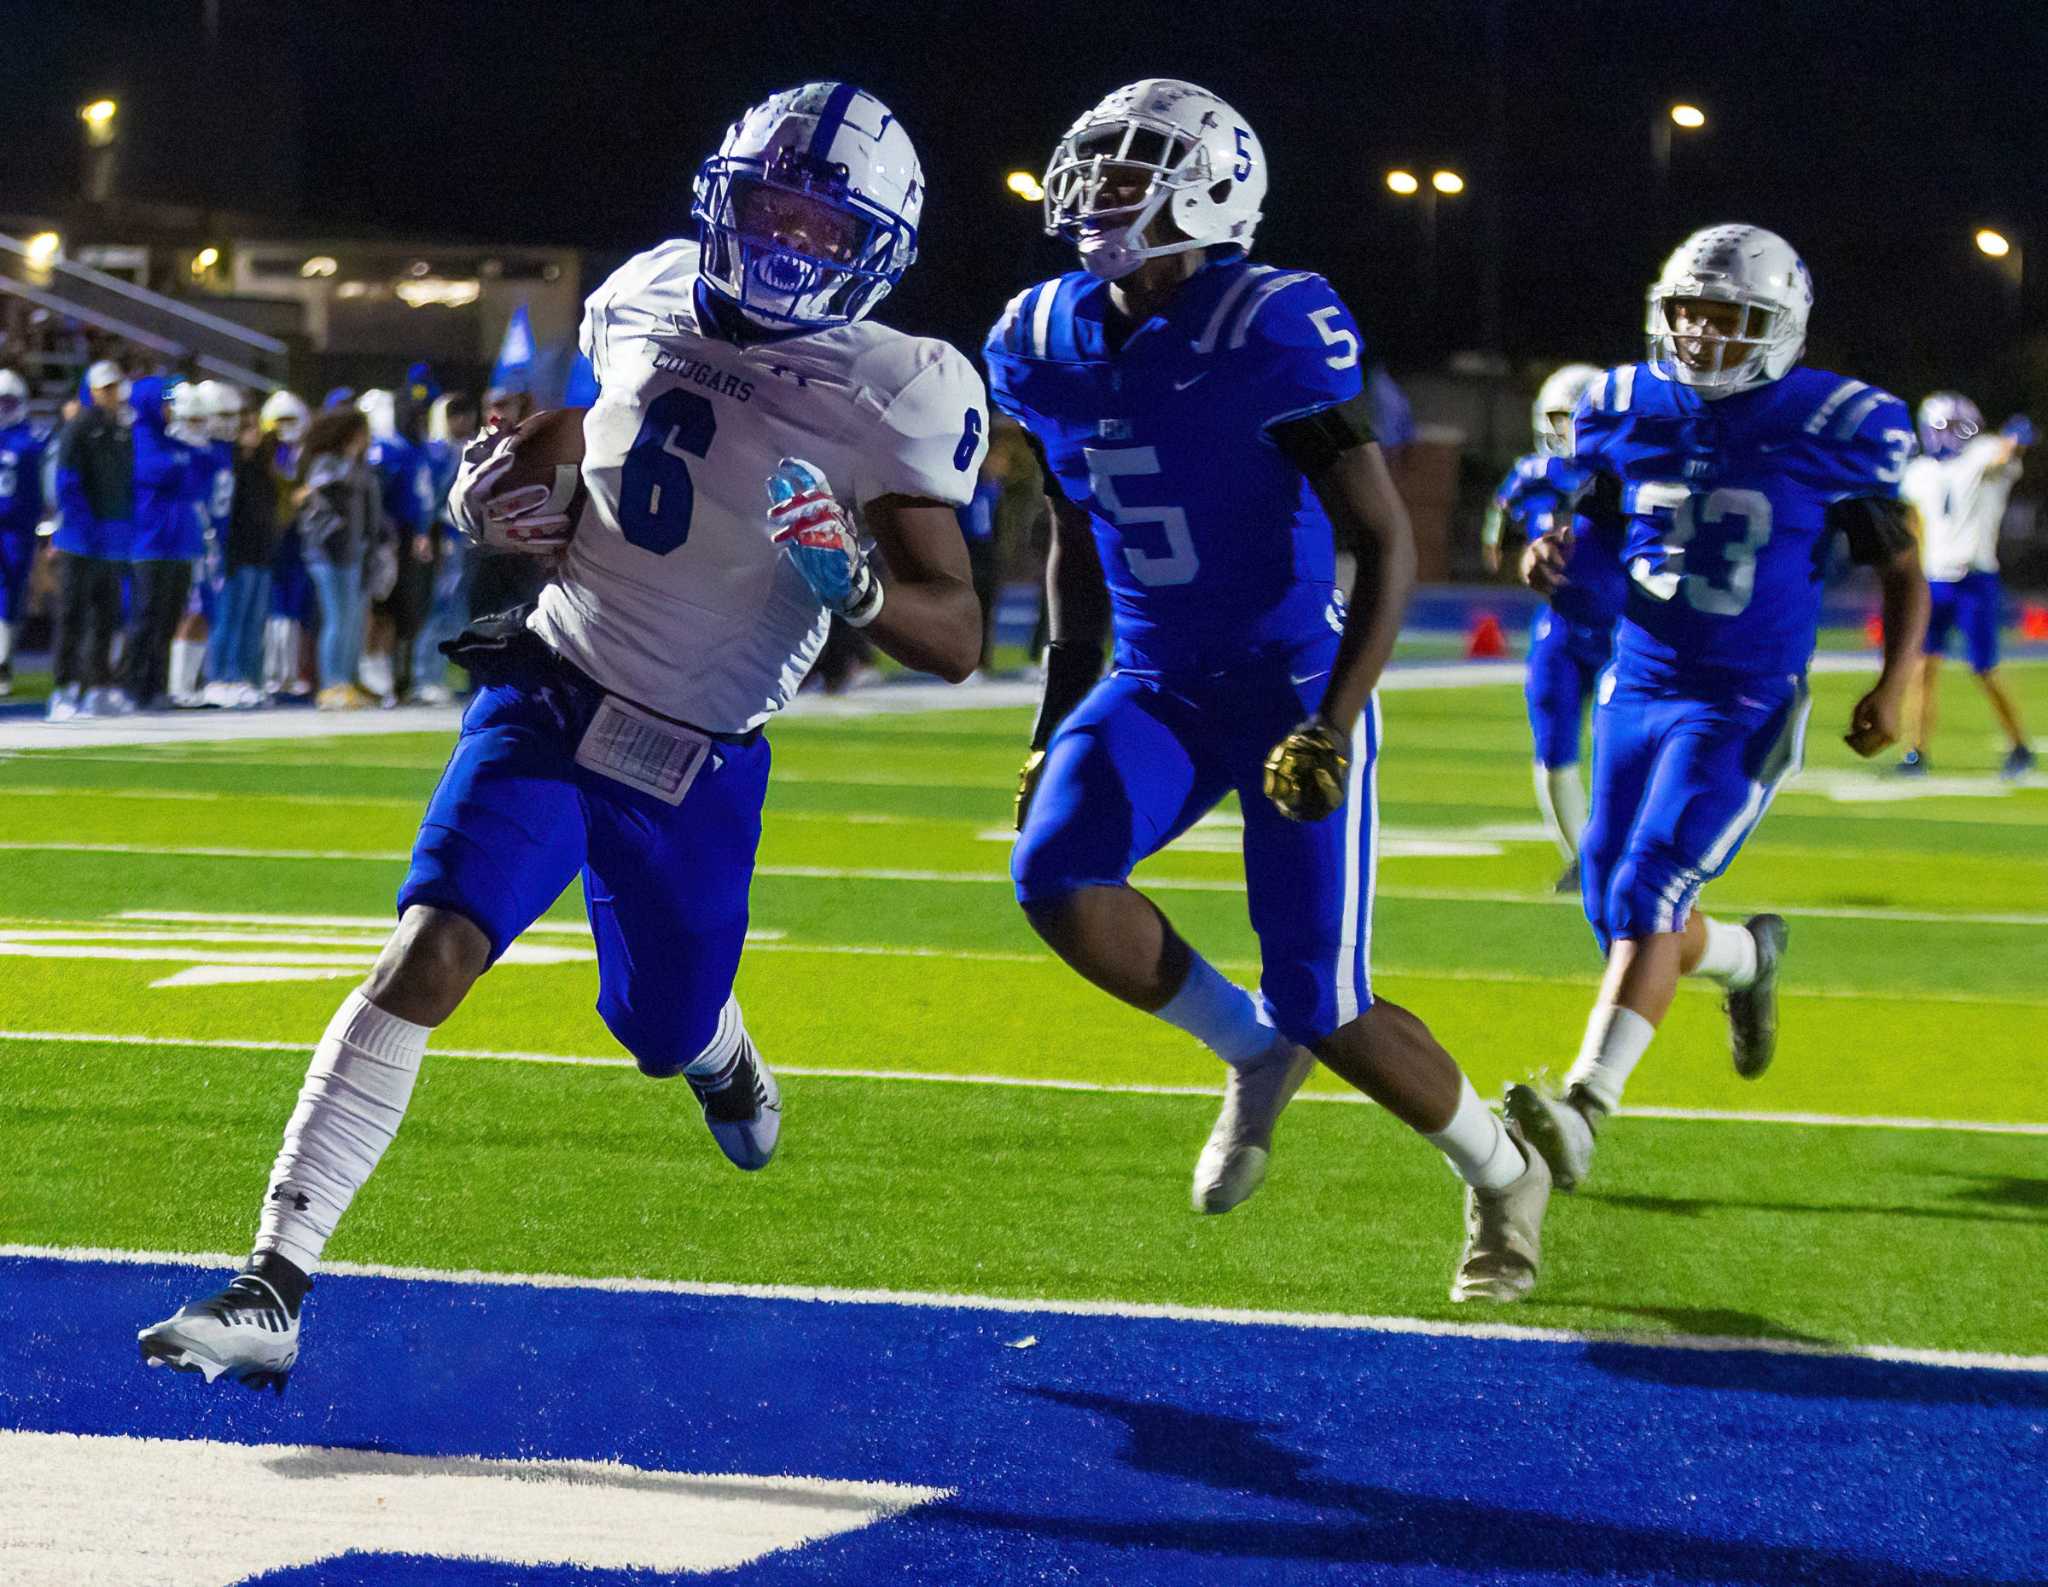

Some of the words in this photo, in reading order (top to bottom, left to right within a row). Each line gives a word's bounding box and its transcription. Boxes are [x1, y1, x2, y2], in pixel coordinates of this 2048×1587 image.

[1233, 126, 1251, 182] 5
[1307, 306, 1359, 371] 5
[652, 350, 755, 403] COUGARS
[618, 387, 717, 556] 6
[953, 407, 982, 472] 6
[1083, 446, 1200, 586] 5
[1631, 481, 1774, 617] 33
